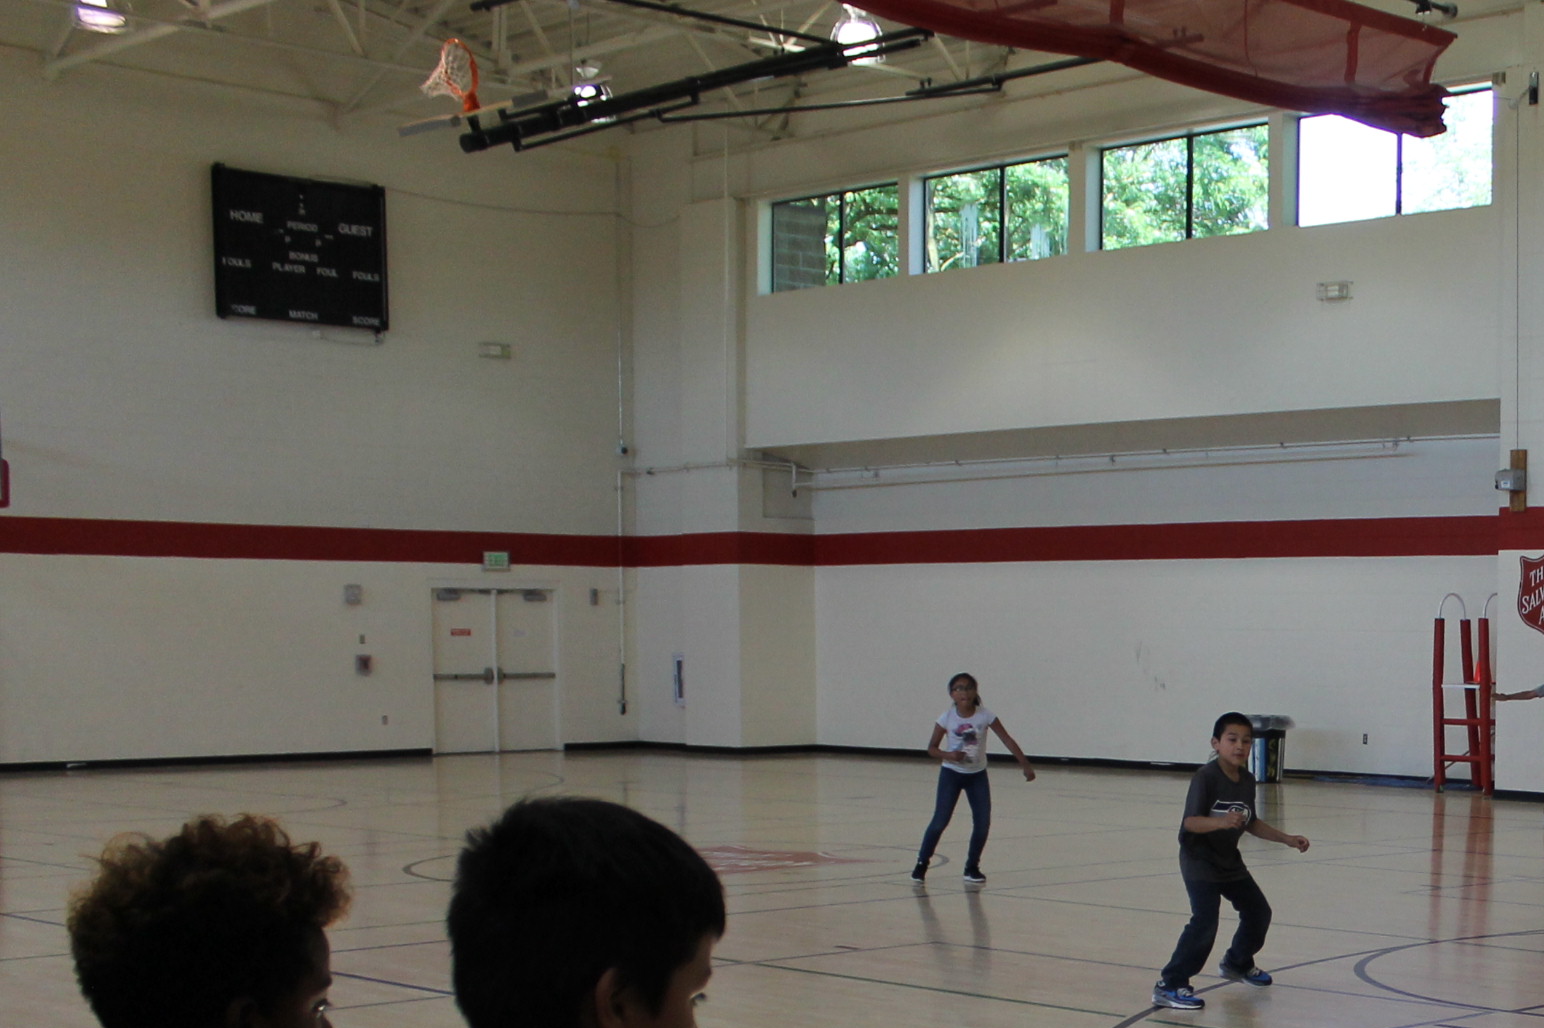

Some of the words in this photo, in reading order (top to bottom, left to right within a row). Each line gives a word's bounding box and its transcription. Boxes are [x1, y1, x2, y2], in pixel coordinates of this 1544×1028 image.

[229, 209, 264, 224] HOME
[286, 220, 318, 233] PERIOD
[338, 222, 373, 237] GUEST
[288, 250, 319, 263] BONUS
[272, 261, 306, 275] PLAYER
[316, 266, 339, 278] FOUL
[352, 270, 380, 283] FOULS
[288, 309, 319, 321] MATCH
[352, 316, 381, 327] SCORE
